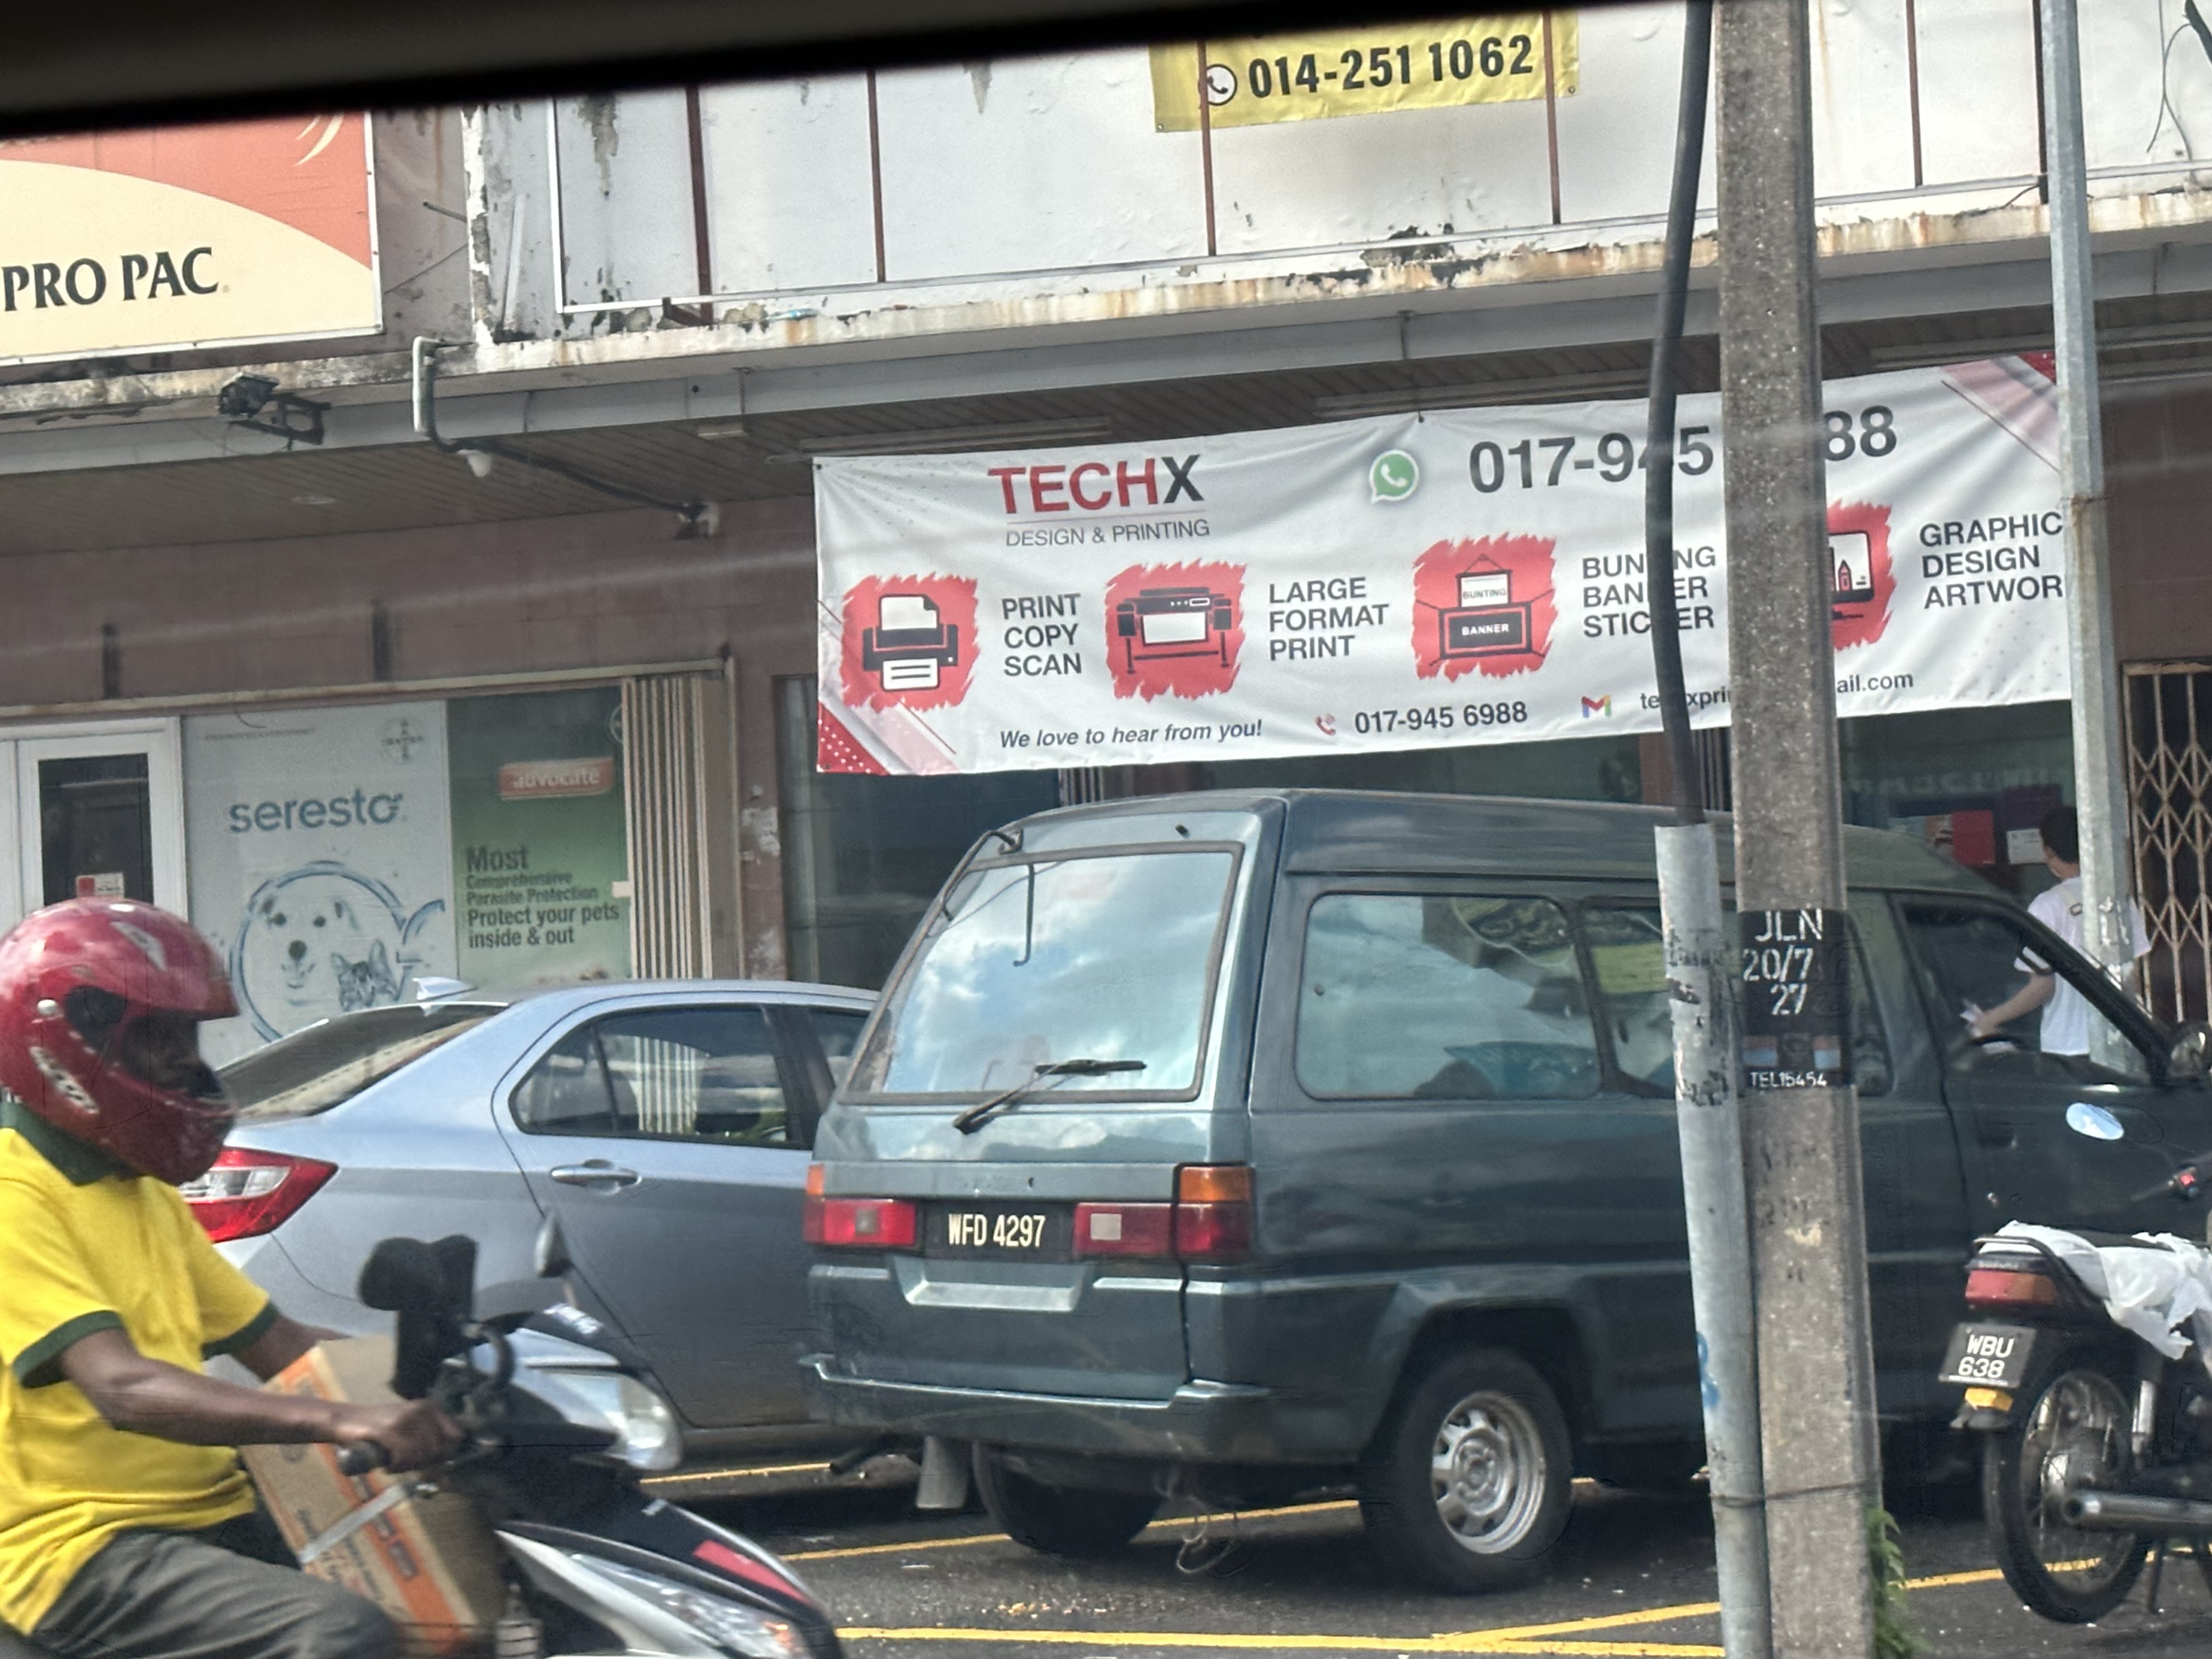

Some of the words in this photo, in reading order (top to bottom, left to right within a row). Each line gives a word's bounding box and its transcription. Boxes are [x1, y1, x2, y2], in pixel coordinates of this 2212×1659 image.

[1249, 45, 1410, 98] 014-251
[1429, 35, 1533, 82] 1062
[1, 258, 107, 312] PRO
[120, 247, 219, 301] PAC
[1469, 426, 1714, 493] 017-95
[988, 454, 1205, 514] TECHX
[1006, 527, 1085, 546] DESIGN
[1091, 527, 1105, 543] &
[1112, 518, 1210, 543] PRINTING
[1920, 511, 2063, 547] GRAPHIC
[1582, 546, 1716, 579] BUNNG
[1922, 545, 2040, 578] DESIGN
[1269, 577, 1367, 603] LARGE
[1583, 575, 1708, 608] BANER
[1924, 574, 2063, 609] ARTWOR
[1001, 593, 1081, 620] PRINT
[1269, 603, 1390, 632] FORMAT
[1583, 606, 1714, 637] STICER
[1004, 623, 1079, 648] COPY
[1462, 623, 1509, 636] BANNER
[1269, 635, 1356, 661] PRINT
[1003, 652, 1082, 676] SCAN
[1355, 706, 1454, 733] 017-945
[1463, 701, 1528, 726] 6988
[1000, 730, 1030, 748] We
[1036, 729, 1079, 747] love
[1085, 729, 1105, 745] to
[1111, 726, 1159, 744] hear
[1164, 723, 1212, 742] from
[1217, 719, 1262, 743] you!
[229, 789, 403, 833] seresto
[466, 845, 529, 872] Most
[467, 908, 531, 927] Protect
[537, 906, 577, 927] your
[580, 902, 620, 925] pets
[1755, 908, 1823, 942] JLN
[468, 929, 522, 949] inside
[527, 927, 540, 945] &
[546, 926, 574, 945] out
[1742, 945, 1814, 982] 20/7
[1770, 983, 1808, 1015] 27
[949, 1213, 986, 1246] WFD
[993, 1214, 1046, 1248] 4297
[1966, 1335, 2015, 1358] WBU
[1957, 1357, 2005, 1378] 638
